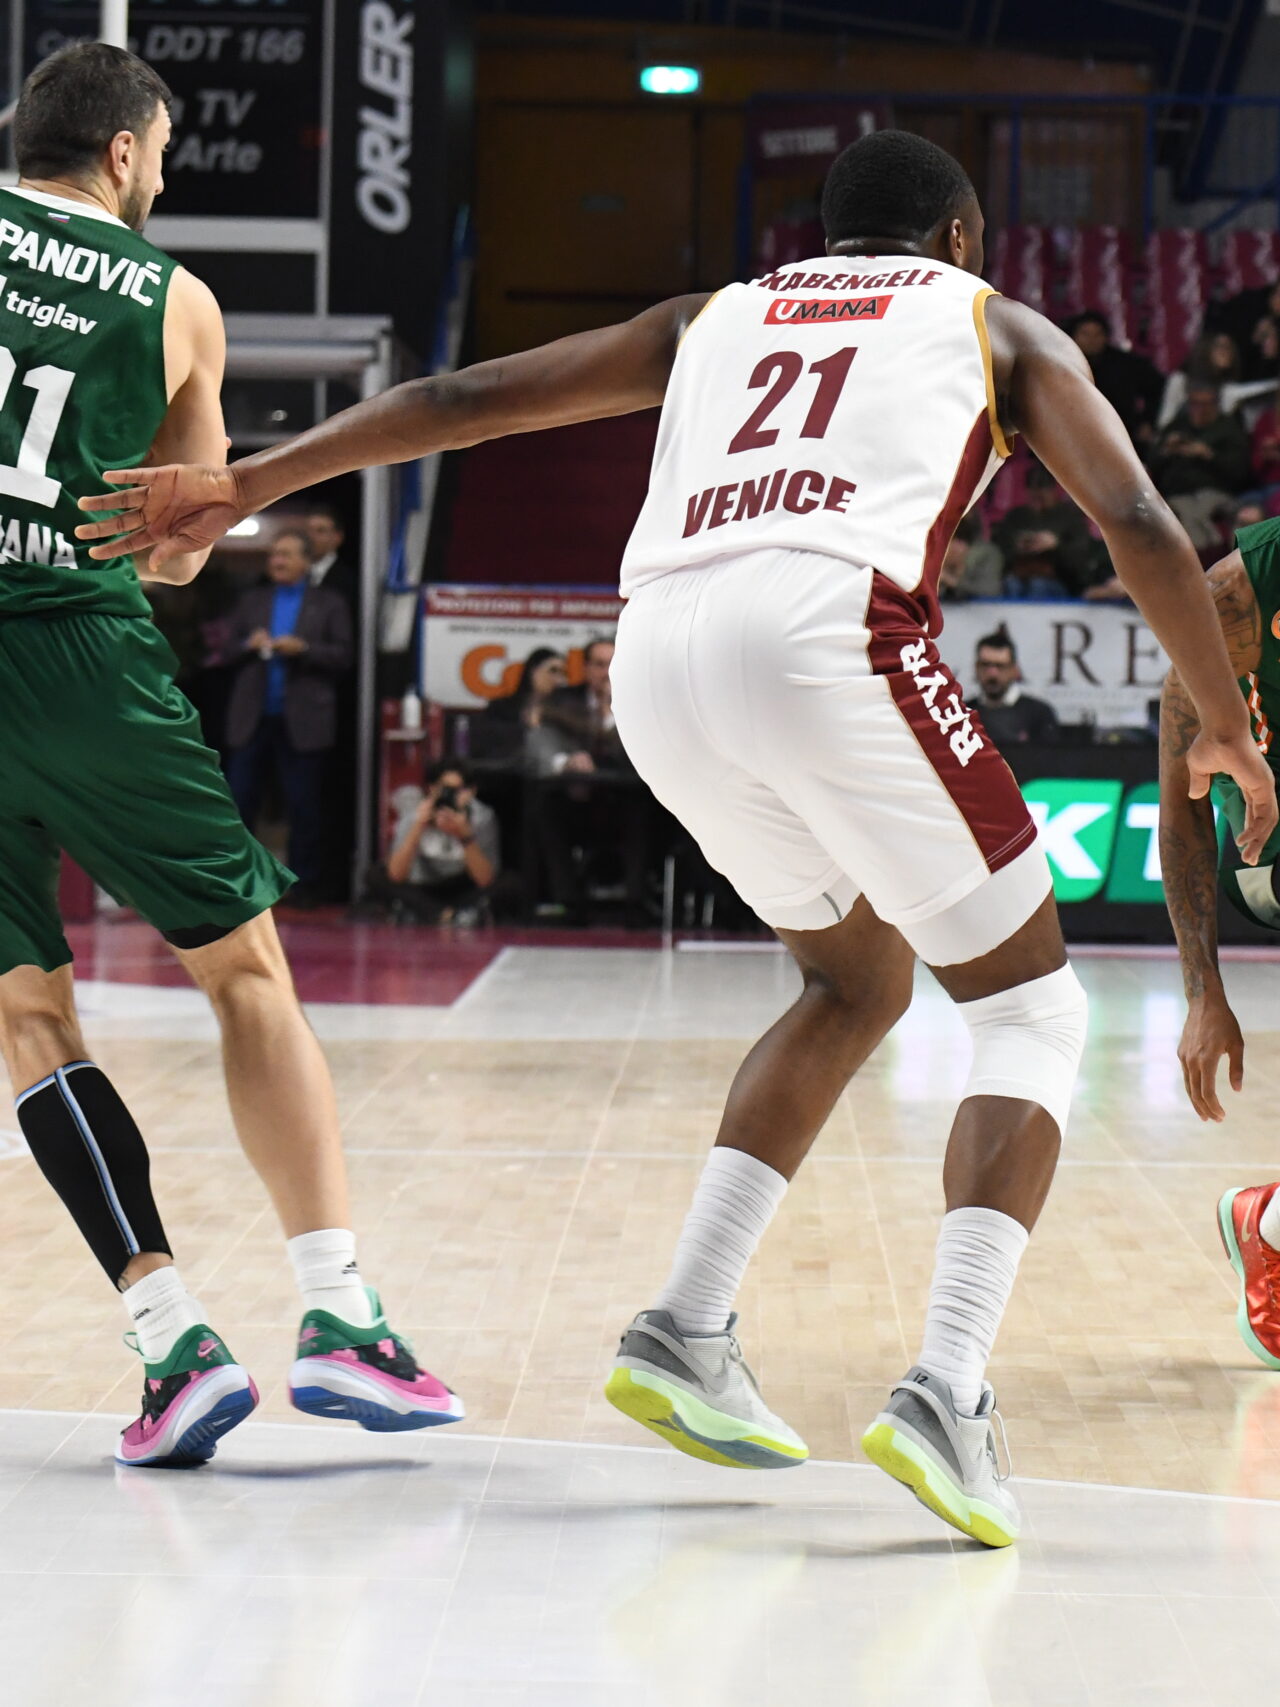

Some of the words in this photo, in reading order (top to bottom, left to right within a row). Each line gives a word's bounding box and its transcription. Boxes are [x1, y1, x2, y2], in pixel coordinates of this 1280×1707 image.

[145, 25, 229, 61] DDT
[236, 28, 306, 65] 166
[196, 89, 257, 127] TV
[356, 1, 414, 234] ORLER
[758, 269, 944, 292] KABENGELE
[6, 291, 97, 335] triglav
[775, 297, 878, 321] UMANA
[727, 346, 859, 455] 21
[681, 468, 857, 539] VENICE
